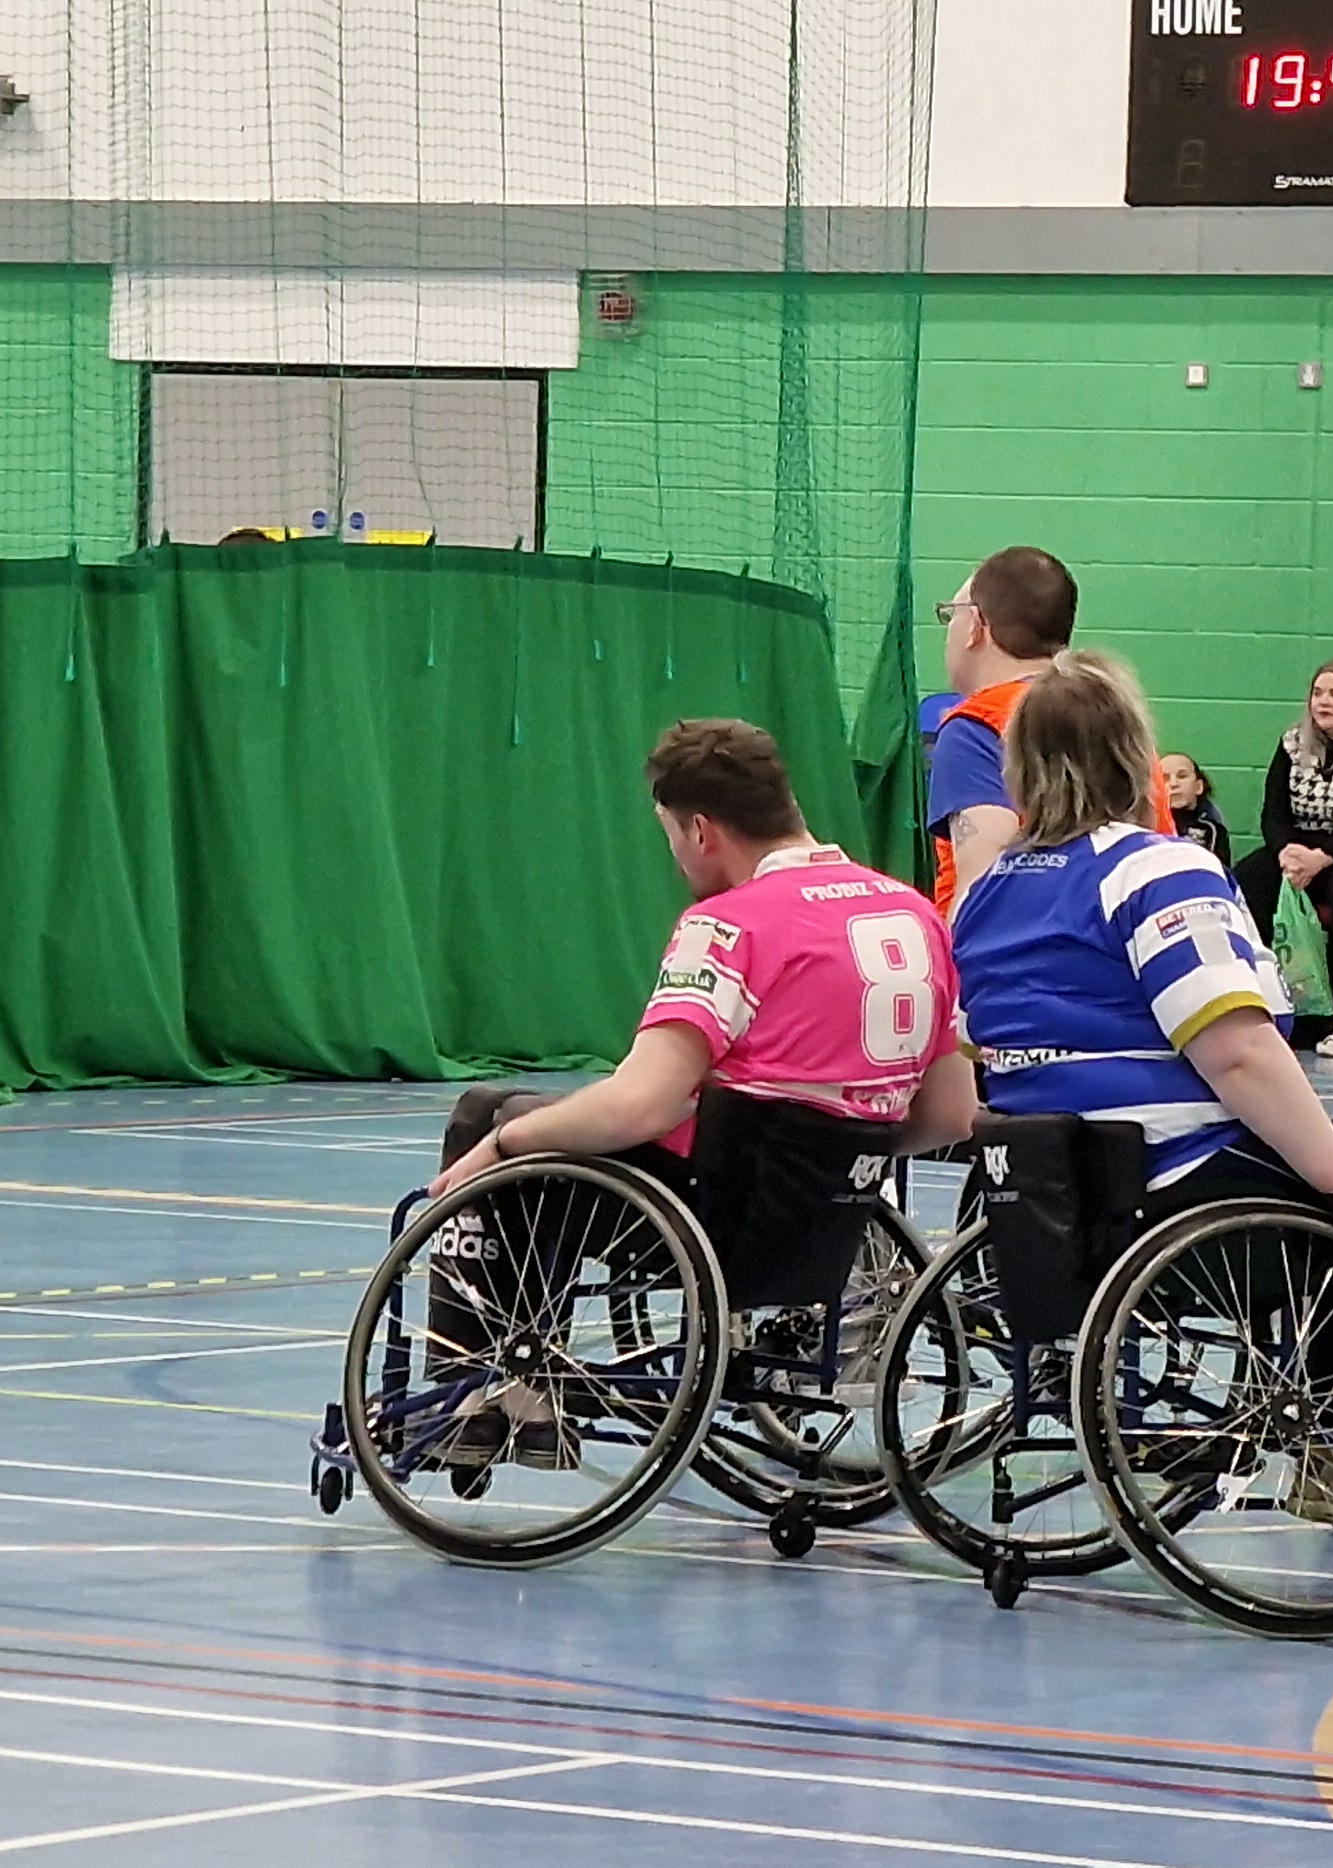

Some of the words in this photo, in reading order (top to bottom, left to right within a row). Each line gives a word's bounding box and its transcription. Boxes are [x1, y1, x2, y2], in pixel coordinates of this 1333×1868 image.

[1150, 0, 1243, 35] HOME
[801, 881, 874, 902] PROBIZ
[847, 910, 935, 1067] 8
